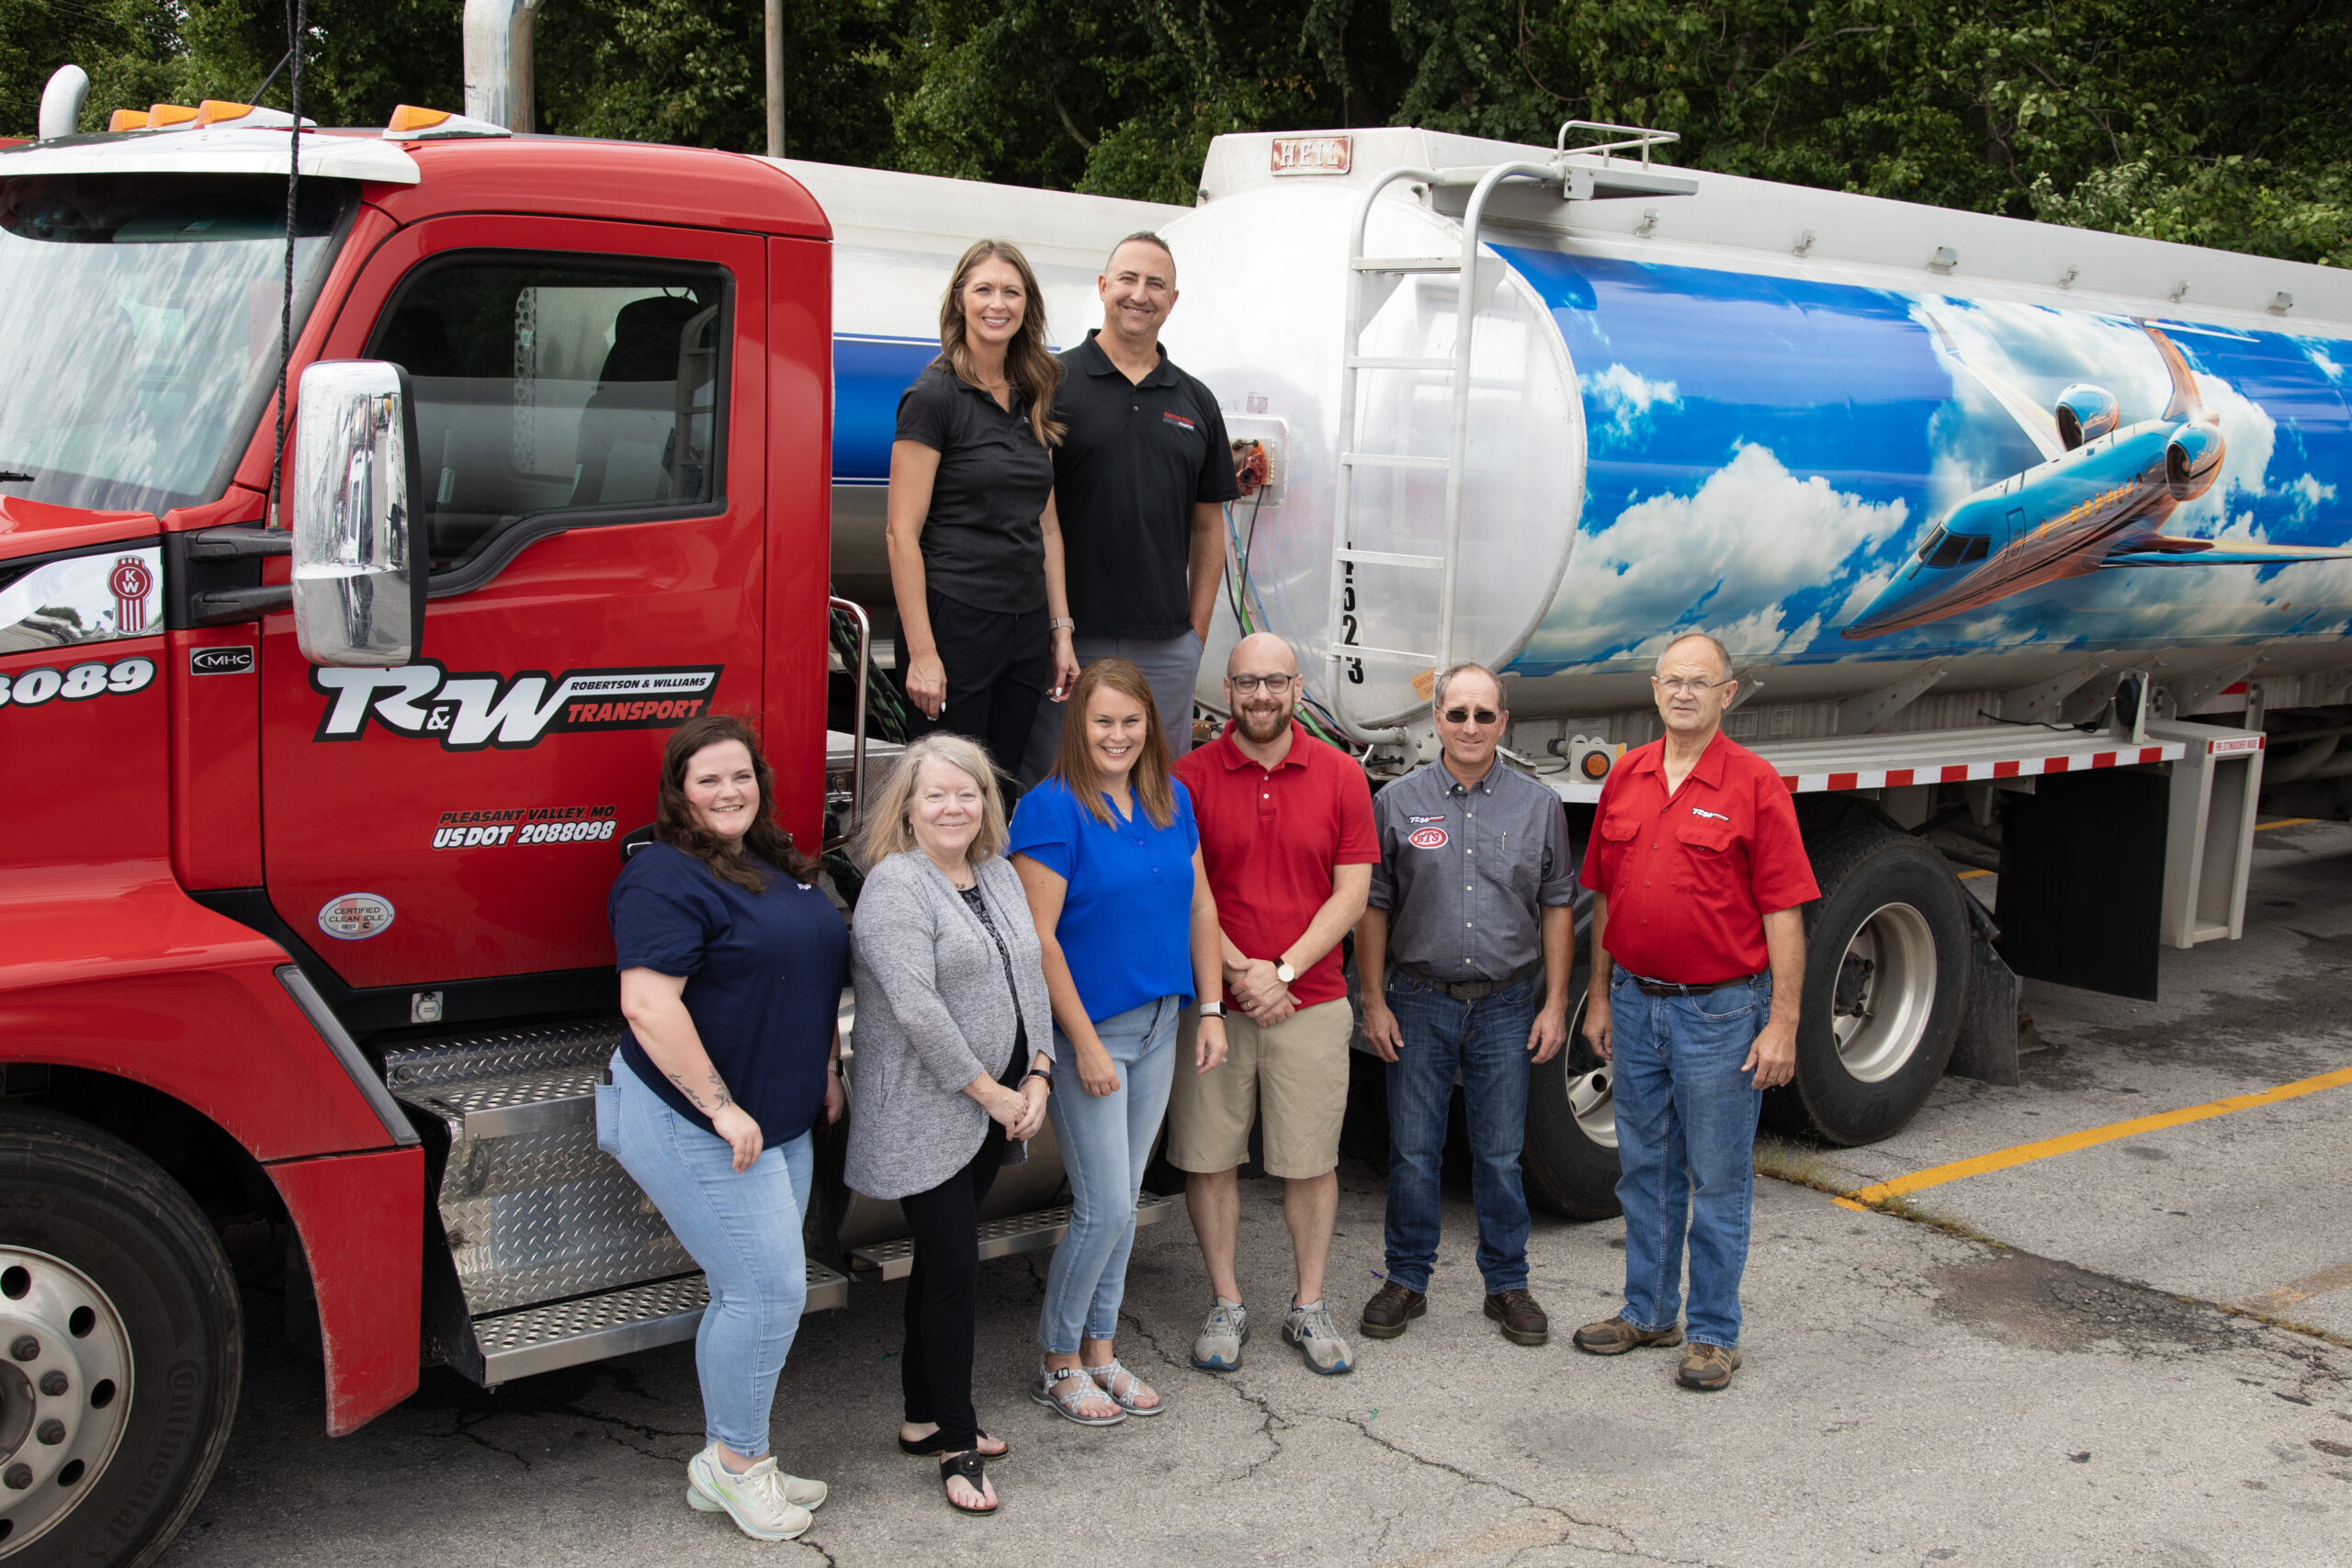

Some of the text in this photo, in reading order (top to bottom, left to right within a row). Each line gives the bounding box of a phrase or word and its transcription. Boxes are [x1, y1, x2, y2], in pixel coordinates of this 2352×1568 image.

[1281, 142, 1339, 167] HEIL
[208, 653, 251, 666] MHC
[0, 656, 155, 707] 089
[570, 677, 707, 691] ROBERTSON & WILLIAMS
[567, 699, 704, 723] TRANSPORT
[439, 806, 616, 824] PLEASANT VALLEY, MO
[432, 820, 616, 849] USDOT 2088098
[334, 907, 381, 915] CERTIFIED
[104, 1359, 202, 1541] Continental
